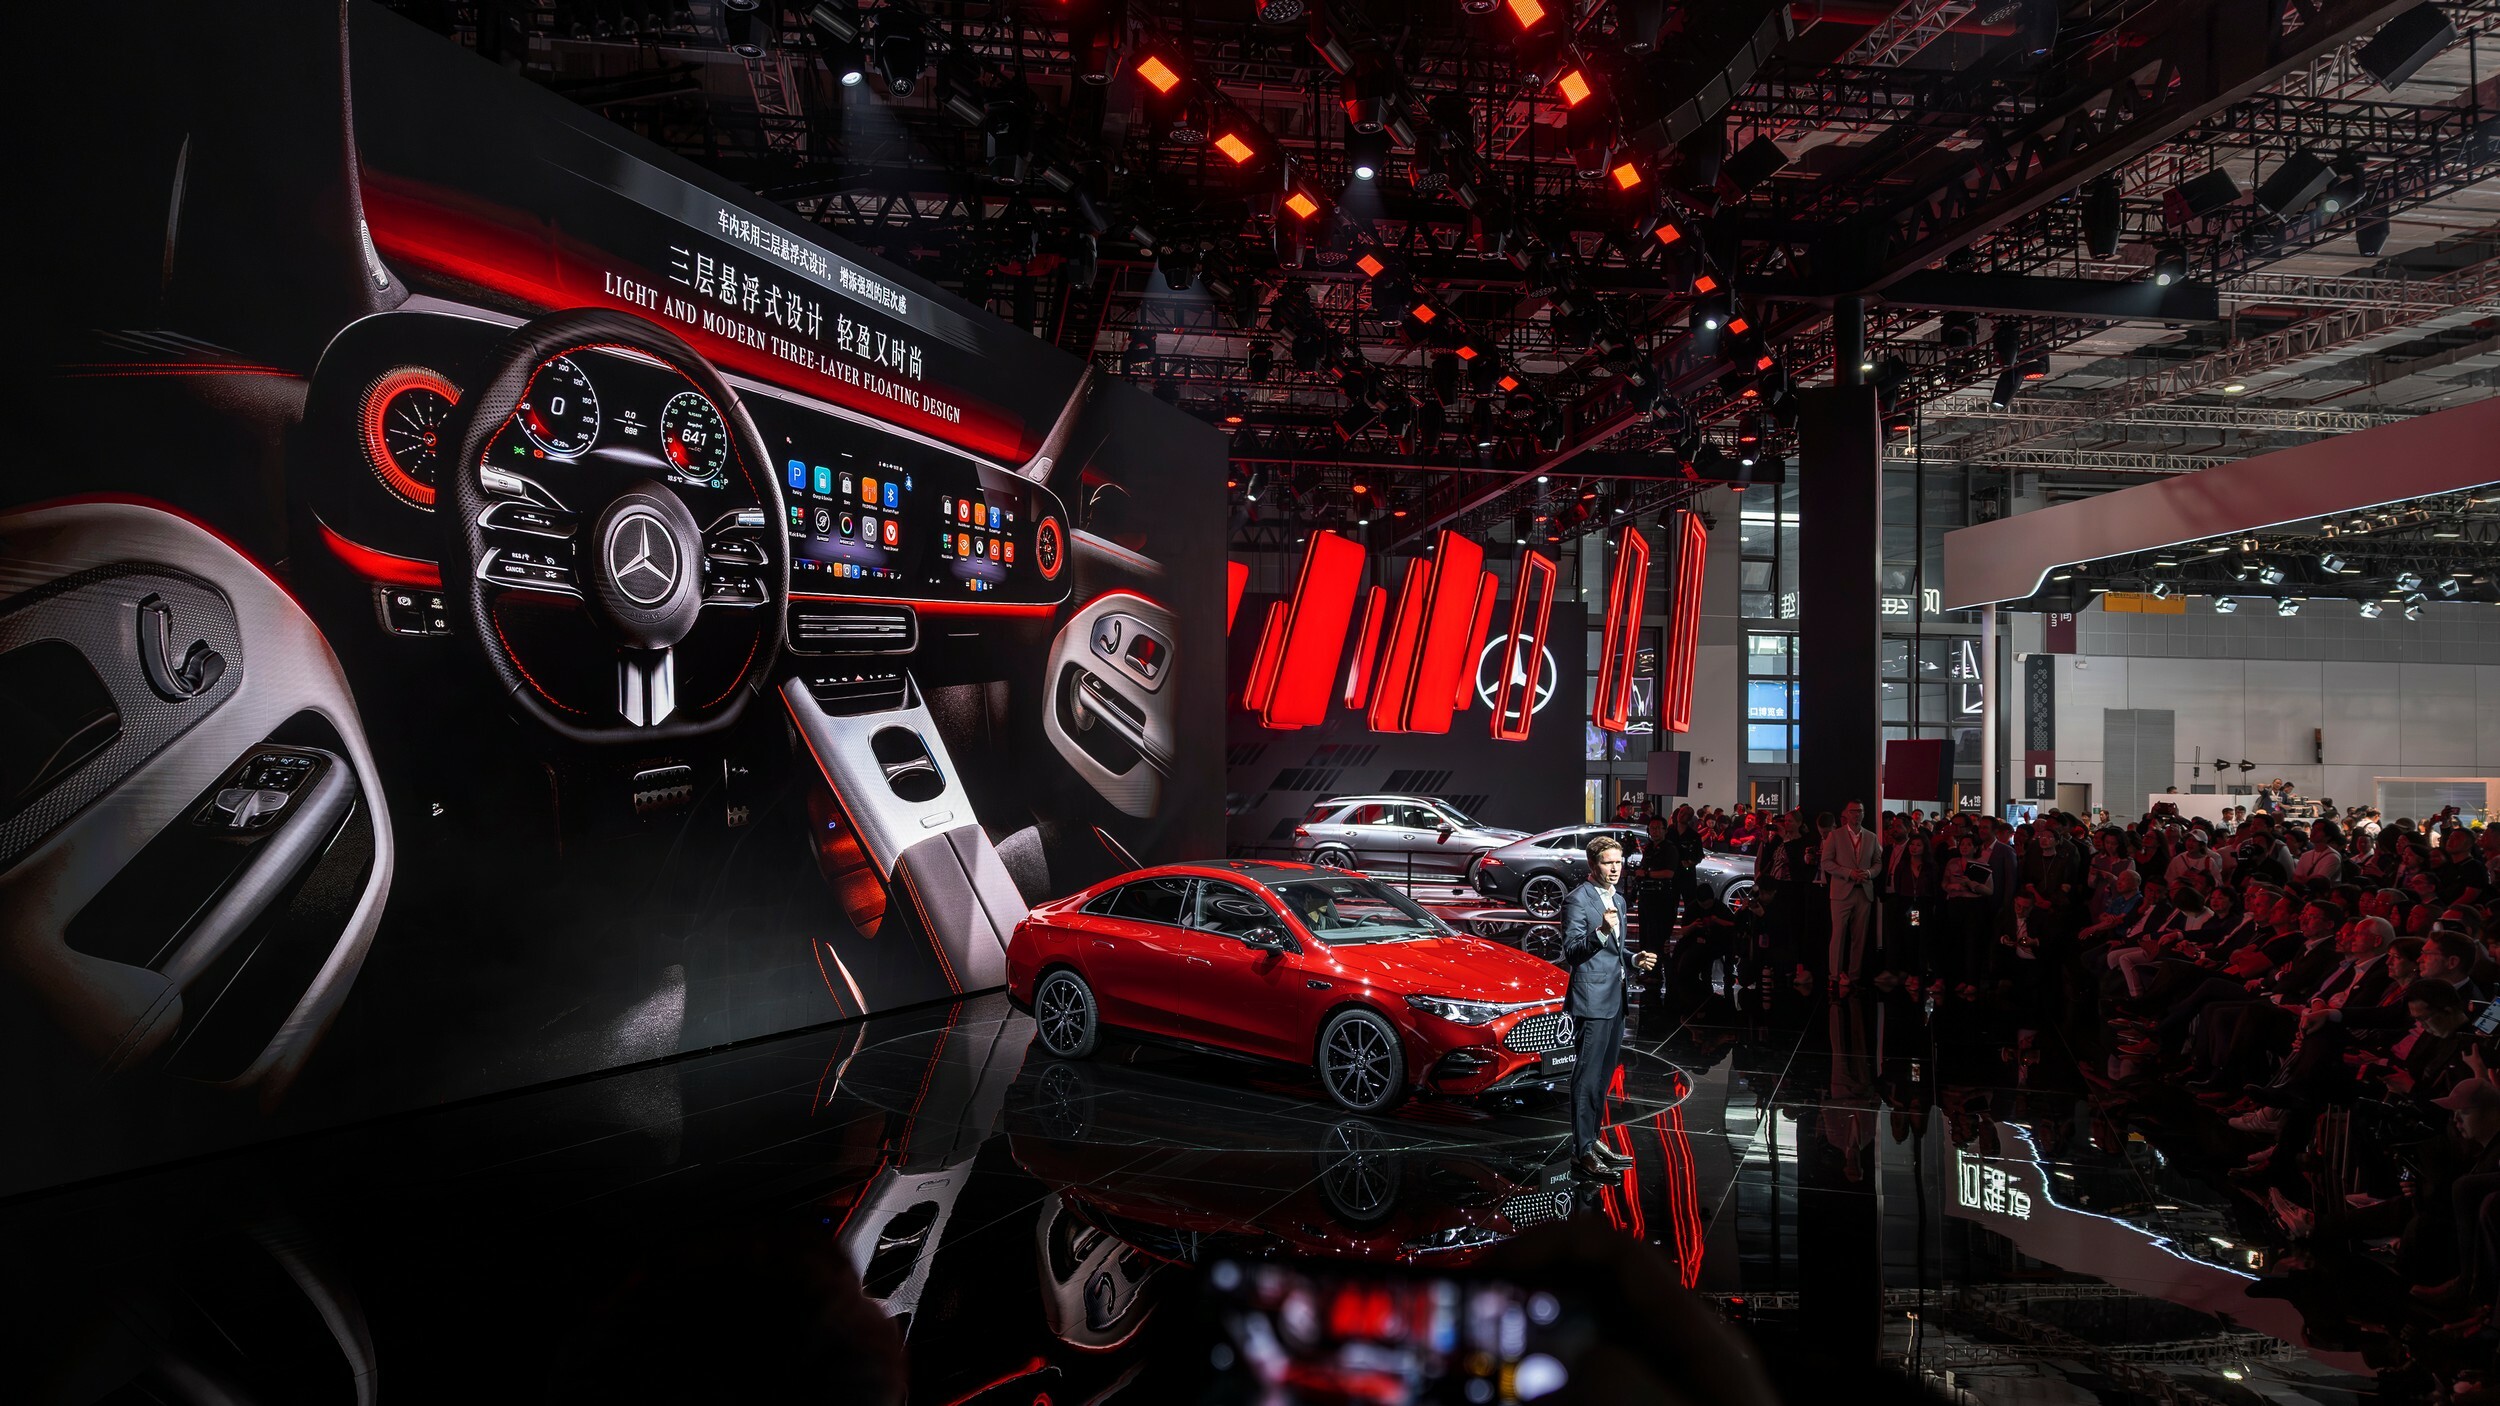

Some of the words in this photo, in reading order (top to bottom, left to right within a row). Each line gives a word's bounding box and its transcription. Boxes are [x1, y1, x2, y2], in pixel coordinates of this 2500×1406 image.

[718, 208, 831, 281] 车内采用三层悬浮式设计，
[839, 266, 907, 314] 增添强烈的层次感
[669, 245, 824, 341] 三层悬浮式设计
[837, 313, 923, 381] 轻盈又时尚
[605, 271, 658, 310] LIGHT
[663, 295, 697, 324] AND
[702, 309, 766, 350] MODERN
[771, 335, 860, 387] THREE-LAYER
[864, 373, 919, 407] FLOATING
[922, 395, 961, 424] DESIGN
[558, 364, 569, 372] 100
[573, 378, 584, 386] 120
[551, 396, 565, 415] 0
[582, 416, 594, 424] 200
[624, 410, 636, 419] 0.0
[682, 428, 707, 446] 641
[505, 565, 525, 574] CANCEL
[1757, 793, 1770, 805] 4.1
[1960, 795, 1973, 807] 4.1
[1552, 1056, 1569, 1065] Electric
